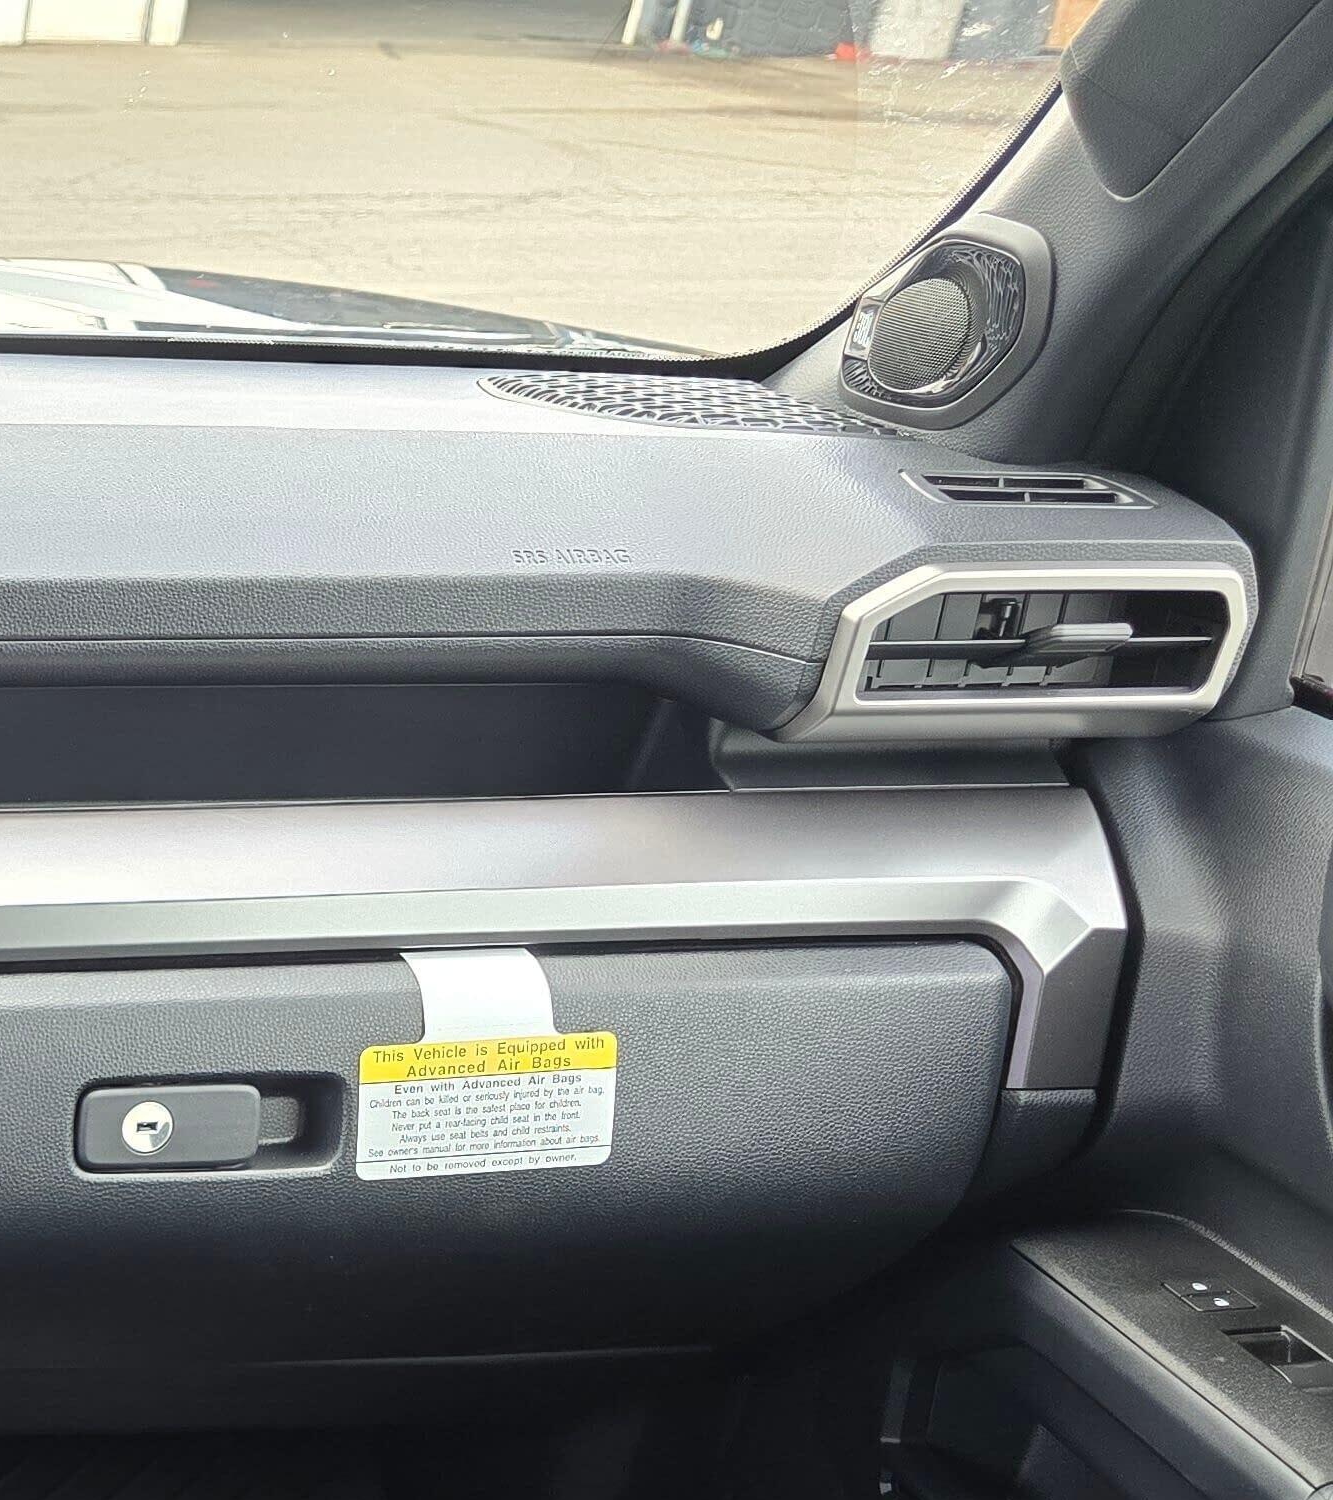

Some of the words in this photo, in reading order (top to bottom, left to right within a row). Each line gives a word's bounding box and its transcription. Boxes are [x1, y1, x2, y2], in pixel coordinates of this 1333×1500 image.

[555, 548, 632, 565] AIRBAG
[373, 1051, 404, 1063] This
[414, 1045, 467, 1060] Vehicle
[476, 1044, 488, 1056] is
[497, 1039, 566, 1056] Equipped
[575, 1037, 604, 1050] with
[406, 1060, 486, 1077] Advanced
[497, 1058, 520, 1071] Air
[532, 1056, 571, 1069] Bags
[394, 1085, 423, 1094] Even
[431, 1082, 455, 1092] with
[462, 1077, 521, 1090] Advanced
[528, 1076, 545, 1085] Air
[553, 1074, 582, 1085] Bags
[369, 1098, 402, 1108] Children
[475, 1090, 509, 1102] seriously
[513, 1089, 540, 1100] injured
[543, 1088, 553, 1098] by
[391, 1123, 414, 1132] Never
[419, 1121, 432, 1132] put
[490, 1115, 508, 1125] child
[512, 1115, 529, 1123] seat
[544, 1112, 557, 1120] the
[392, 1111, 406, 1119] The
[411, 1108, 430, 1118] back
[434, 1107, 451, 1117] seat
[399, 1134, 427, 1145] Always
[432, 1133, 445, 1141] use
[450, 1131, 466, 1140] seat
[493, 1128, 507, 1137] and
[512, 1126, 530, 1136] child
[368, 1149, 383, 1157] See
[422, 1144, 451, 1153] manual
[455, 1143, 466, 1151] for
[470, 1142, 489, 1150] more
[494, 1137, 536, 1148] information
[540, 1136, 562, 1145] about
[566, 1135, 576, 1143] air
[390, 1164, 406, 1173] Not
[412, 1163, 421, 1171] to
[427, 1161, 438, 1170] be
[445, 1159, 486, 1169] removed
[492, 1156, 523, 1167] except
[528, 1155, 540, 1165] by
